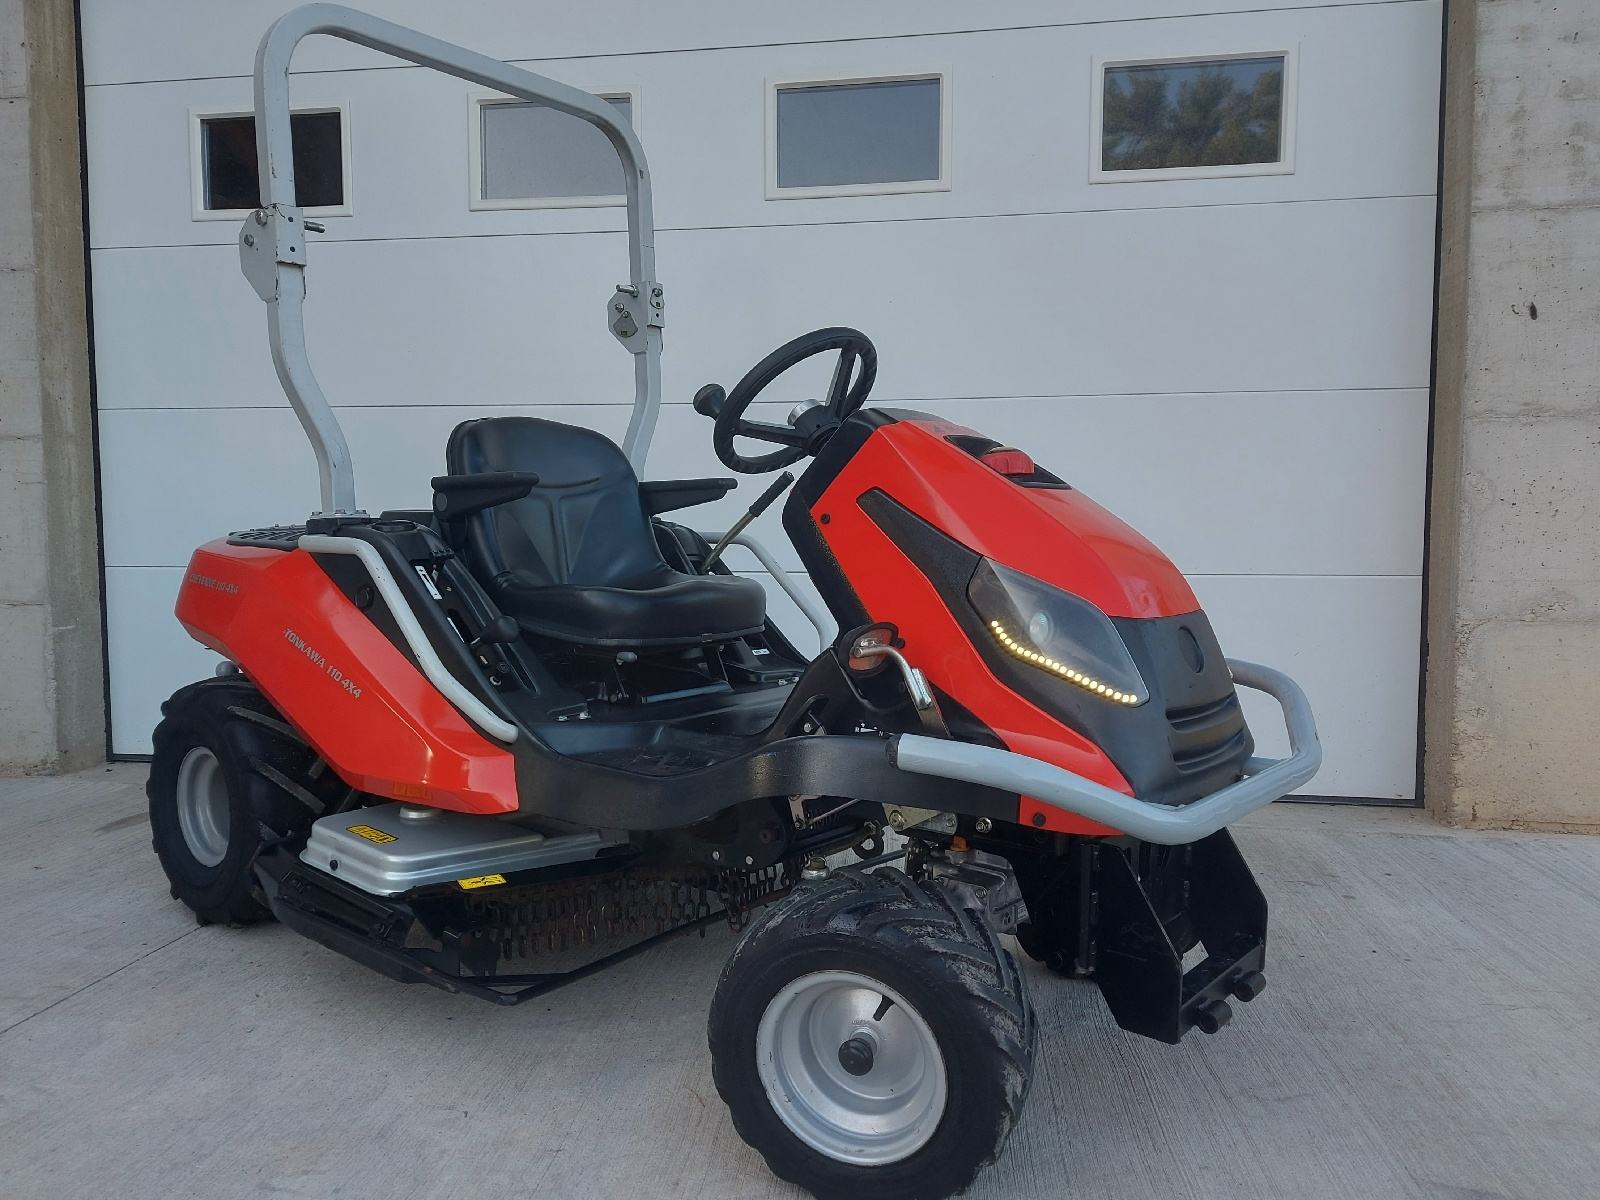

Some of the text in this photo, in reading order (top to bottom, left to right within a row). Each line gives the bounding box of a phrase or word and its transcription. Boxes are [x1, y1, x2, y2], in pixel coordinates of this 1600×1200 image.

[283, 628, 362, 699] TONKAWA 110 4X4
